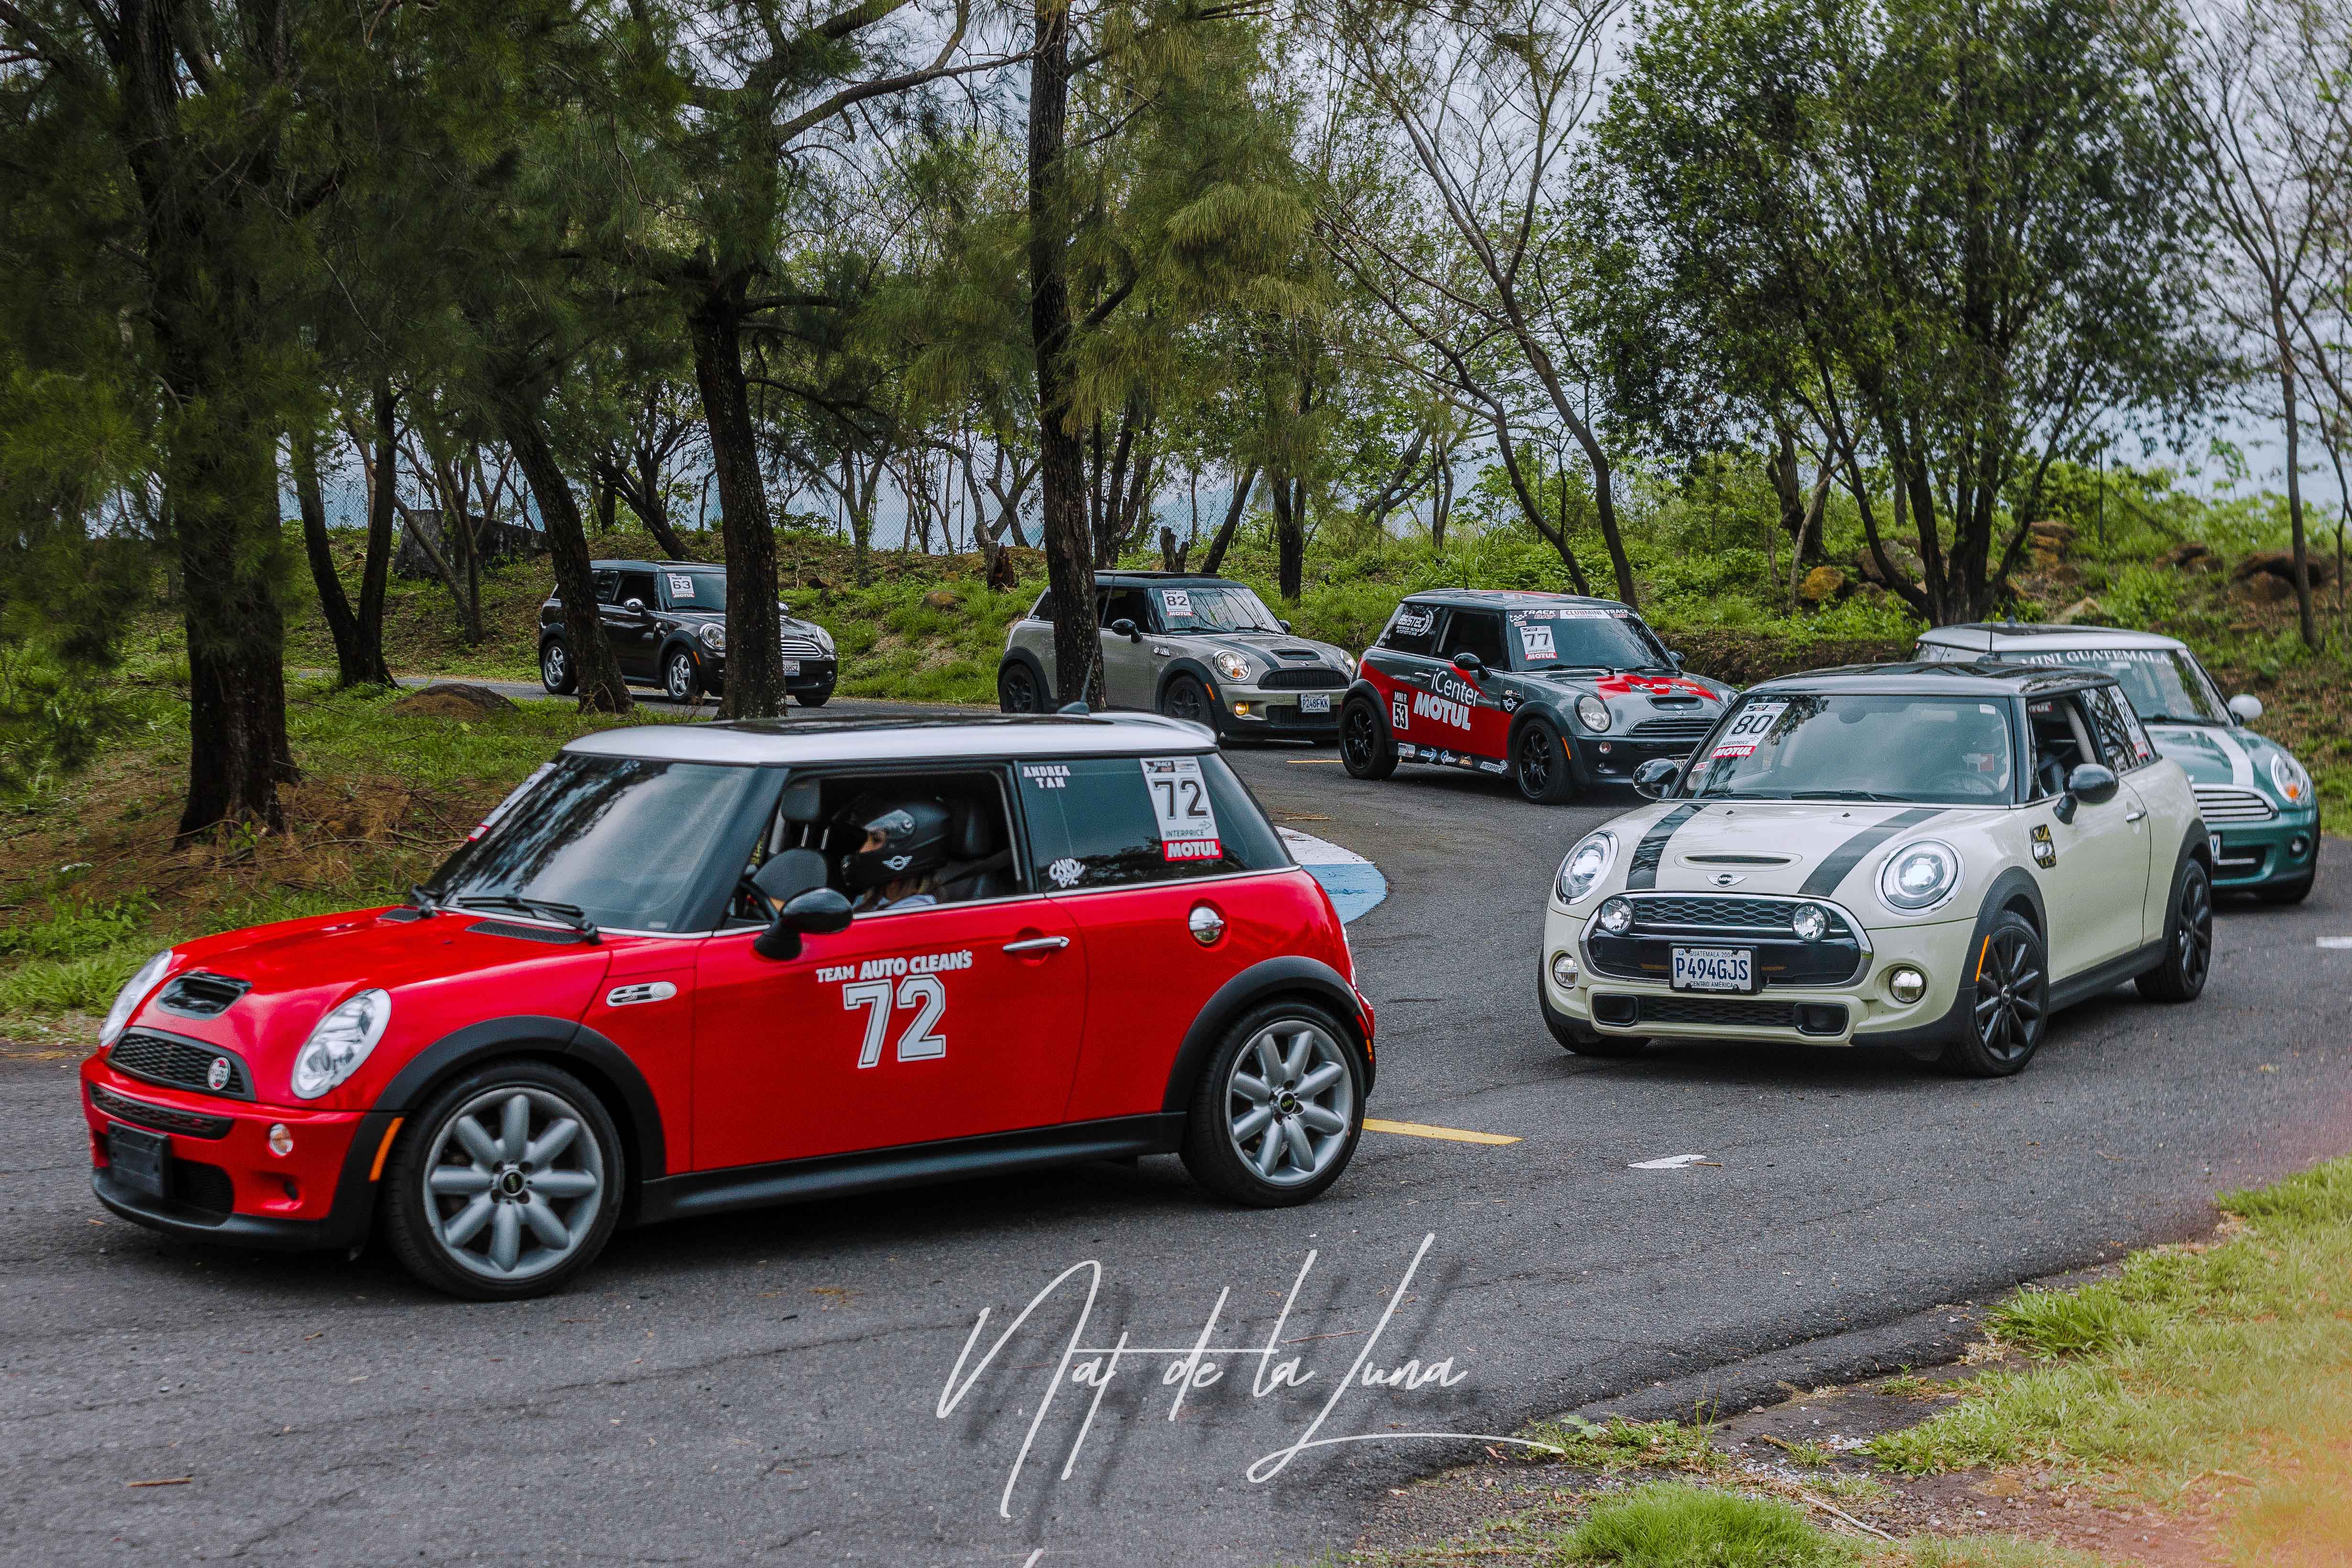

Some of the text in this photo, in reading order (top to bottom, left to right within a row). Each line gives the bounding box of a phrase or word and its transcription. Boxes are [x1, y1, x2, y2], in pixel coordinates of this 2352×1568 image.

[673, 581, 690, 589] 63
[1166, 596, 1188, 606] 82
[1524, 633, 1550, 647] 77
[2066, 650, 2174, 665] GUATEMALA
[1431, 667, 1479, 707] iCenter
[1632, 682, 1699, 692] iCenter
[1394, 692, 1403, 702] MINI
[1395, 703, 1407, 729] 53
[1413, 692, 1471, 731] MOTUL
[1729, 714, 1776, 736] 80
[1713, 746, 1753, 757] MOTUL
[1023, 765, 1071, 778] ANDREA
[1480, 761, 1504, 773] INTERPRICE
[1151, 777, 1210, 820] 72
[1165, 829, 1204, 837] INTERPRICE
[1167, 841, 1220, 858] MOTUL
[816, 965, 855, 983] TEAM
[859, 958, 908, 980] AUTO
[1675, 957, 1748, 980] P494GJS
[842, 973, 946, 1069] 72
